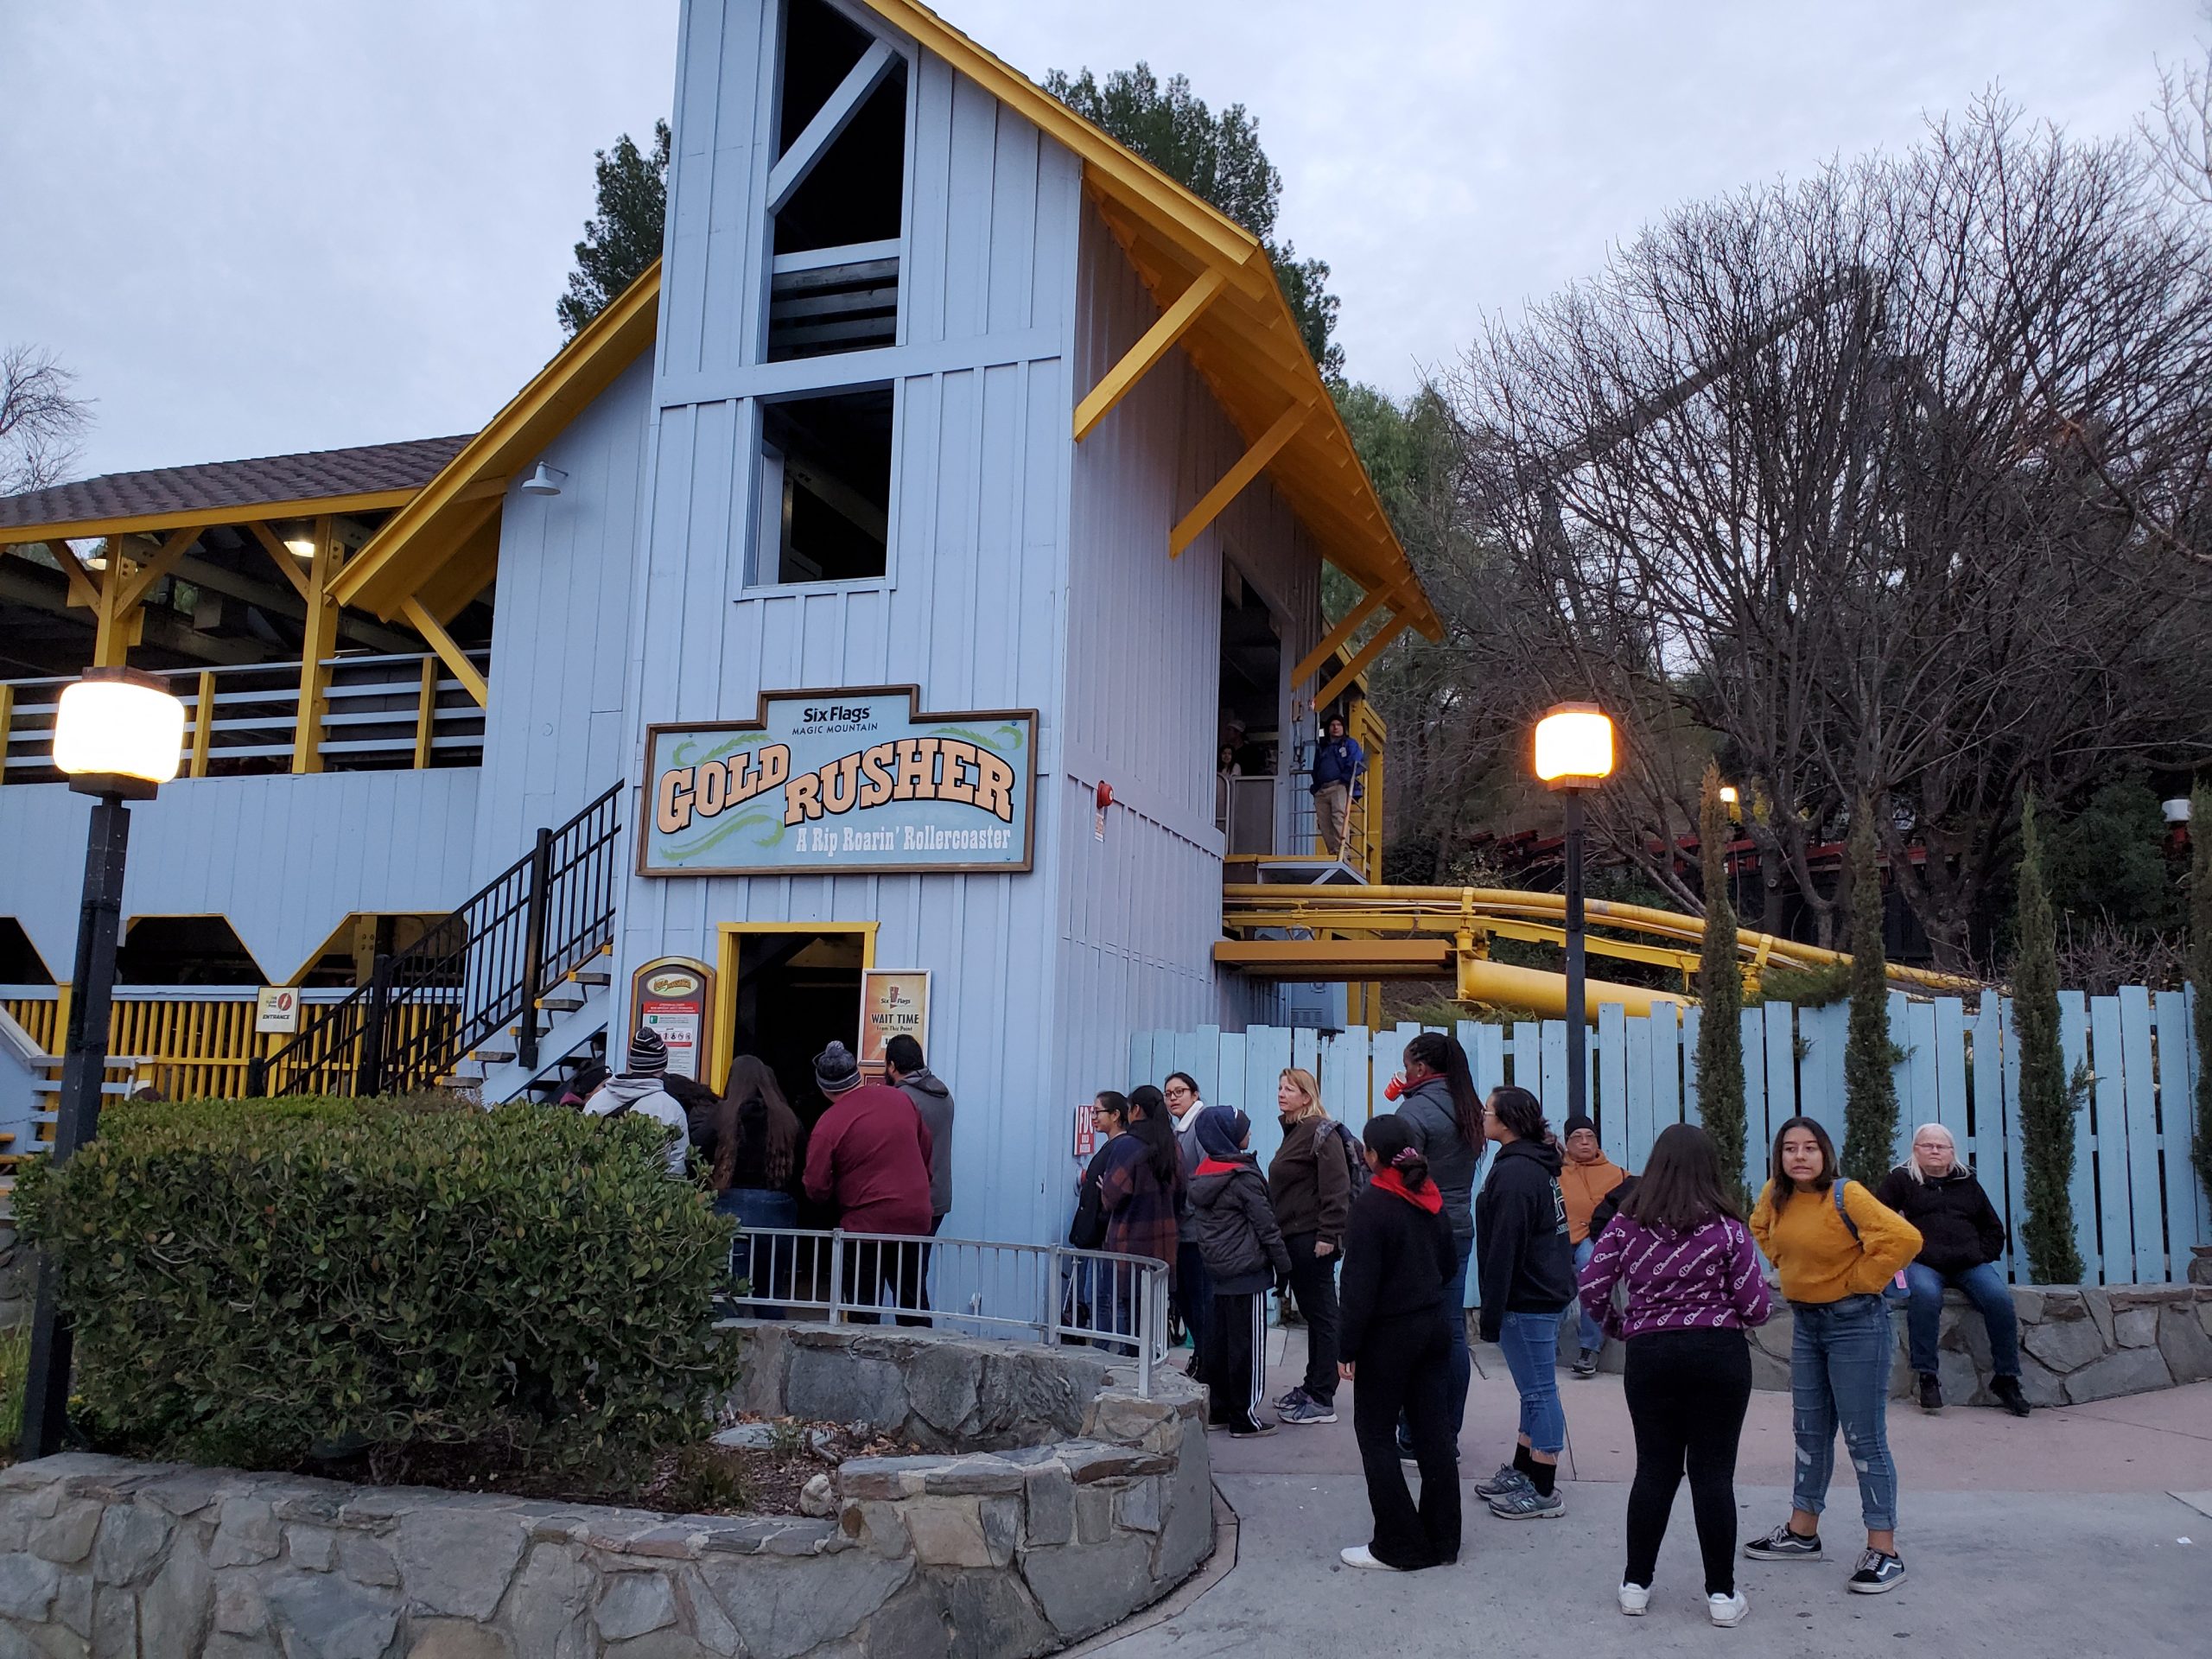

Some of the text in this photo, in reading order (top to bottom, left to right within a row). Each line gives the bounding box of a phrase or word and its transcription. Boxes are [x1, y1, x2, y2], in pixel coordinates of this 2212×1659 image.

[803, 706, 870, 723] Six Flags
[791, 722, 878, 735] MAGIC MOUNTAIN
[657, 737, 1015, 835] GOLD RUSHER
[796, 827, 807, 852] A
[811, 827, 837, 857] Rip
[903, 825, 1011, 850] Rollercoaster
[872, 1014, 919, 1024] WAIT TIME
